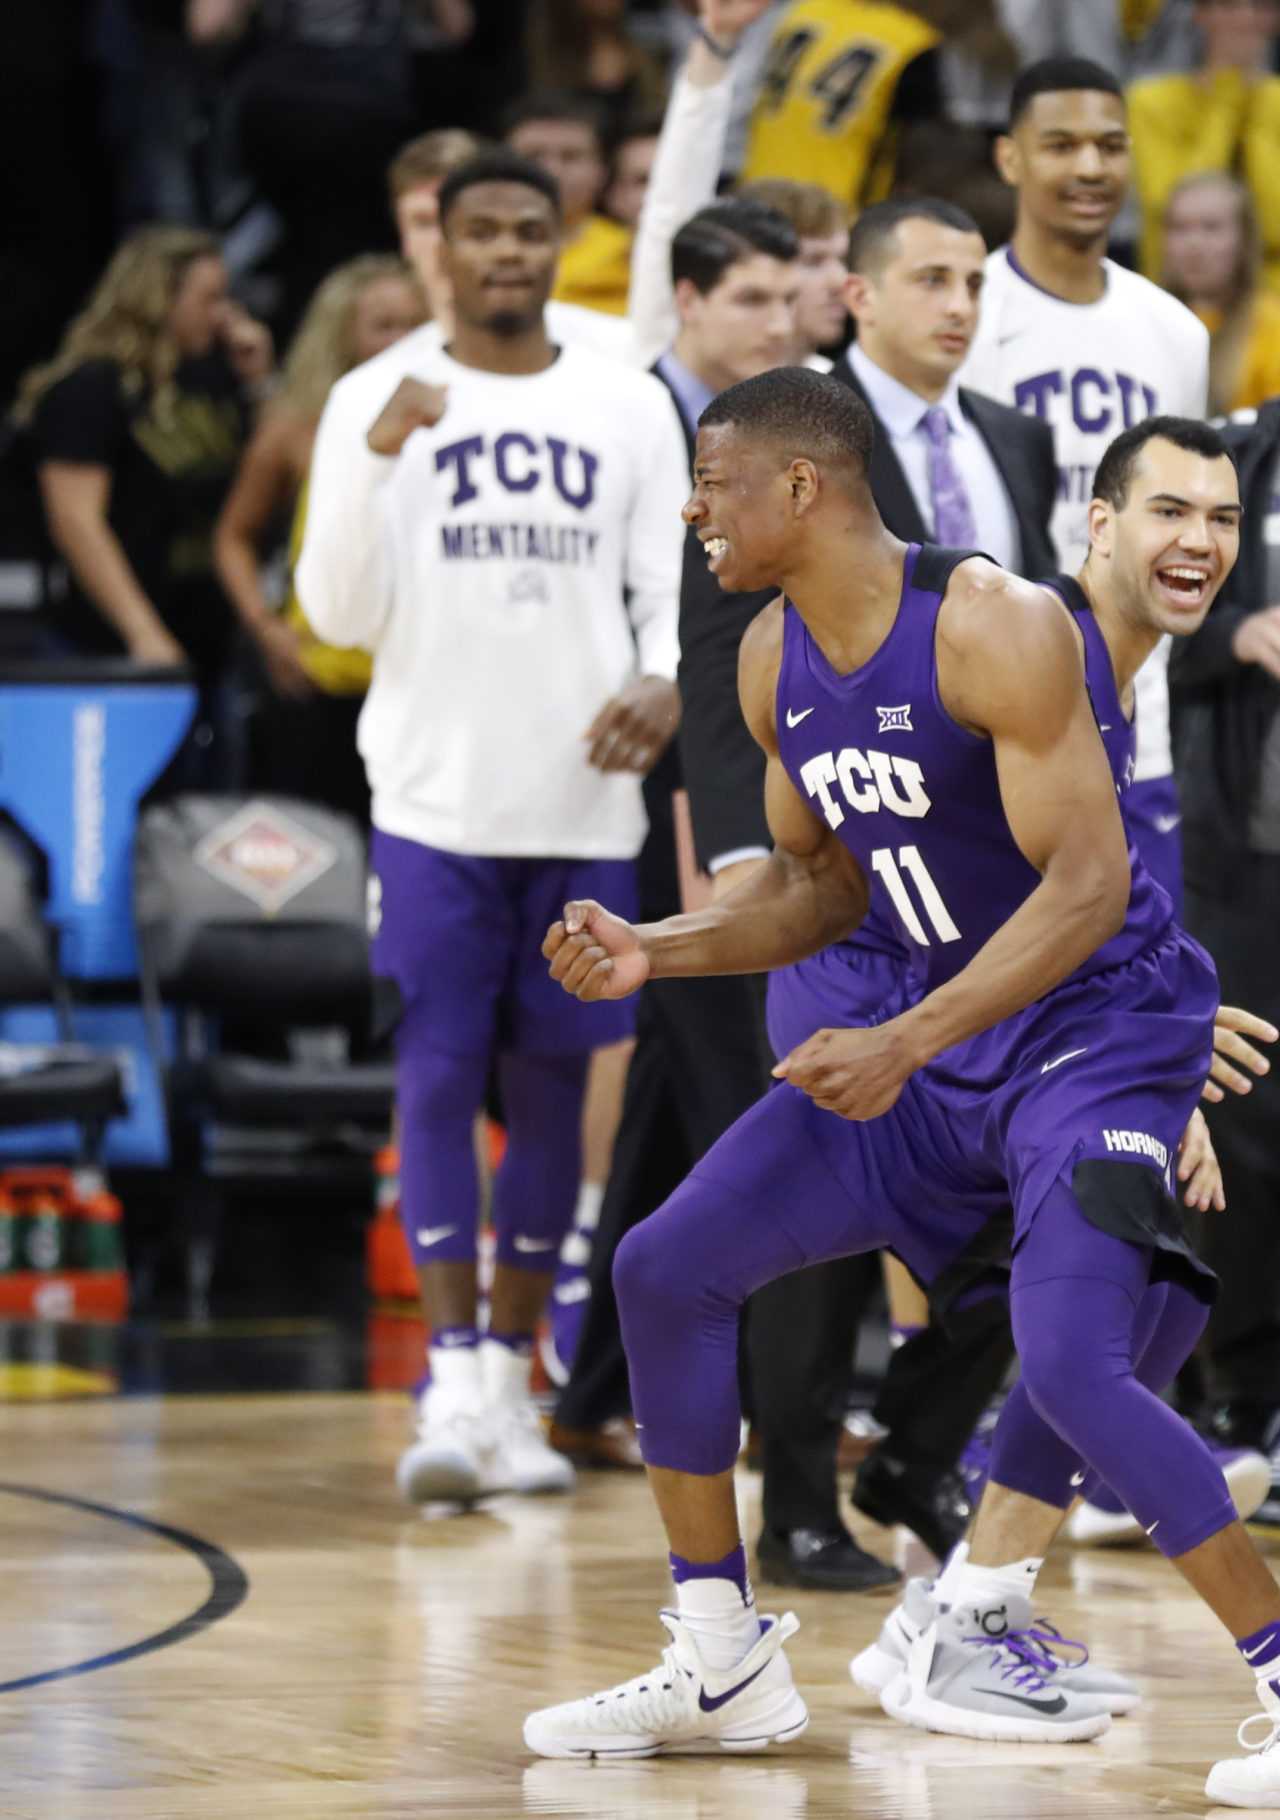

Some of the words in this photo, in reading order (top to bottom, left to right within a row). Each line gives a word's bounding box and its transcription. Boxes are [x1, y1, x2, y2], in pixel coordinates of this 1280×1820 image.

[766, 31, 877, 127] 44
[435, 432, 599, 510] TCU
[441, 522, 601, 565] MENTALITY
[799, 747, 933, 832] TCU
[871, 845, 963, 947] 11
[1102, 1129, 1168, 1169] HORNED
